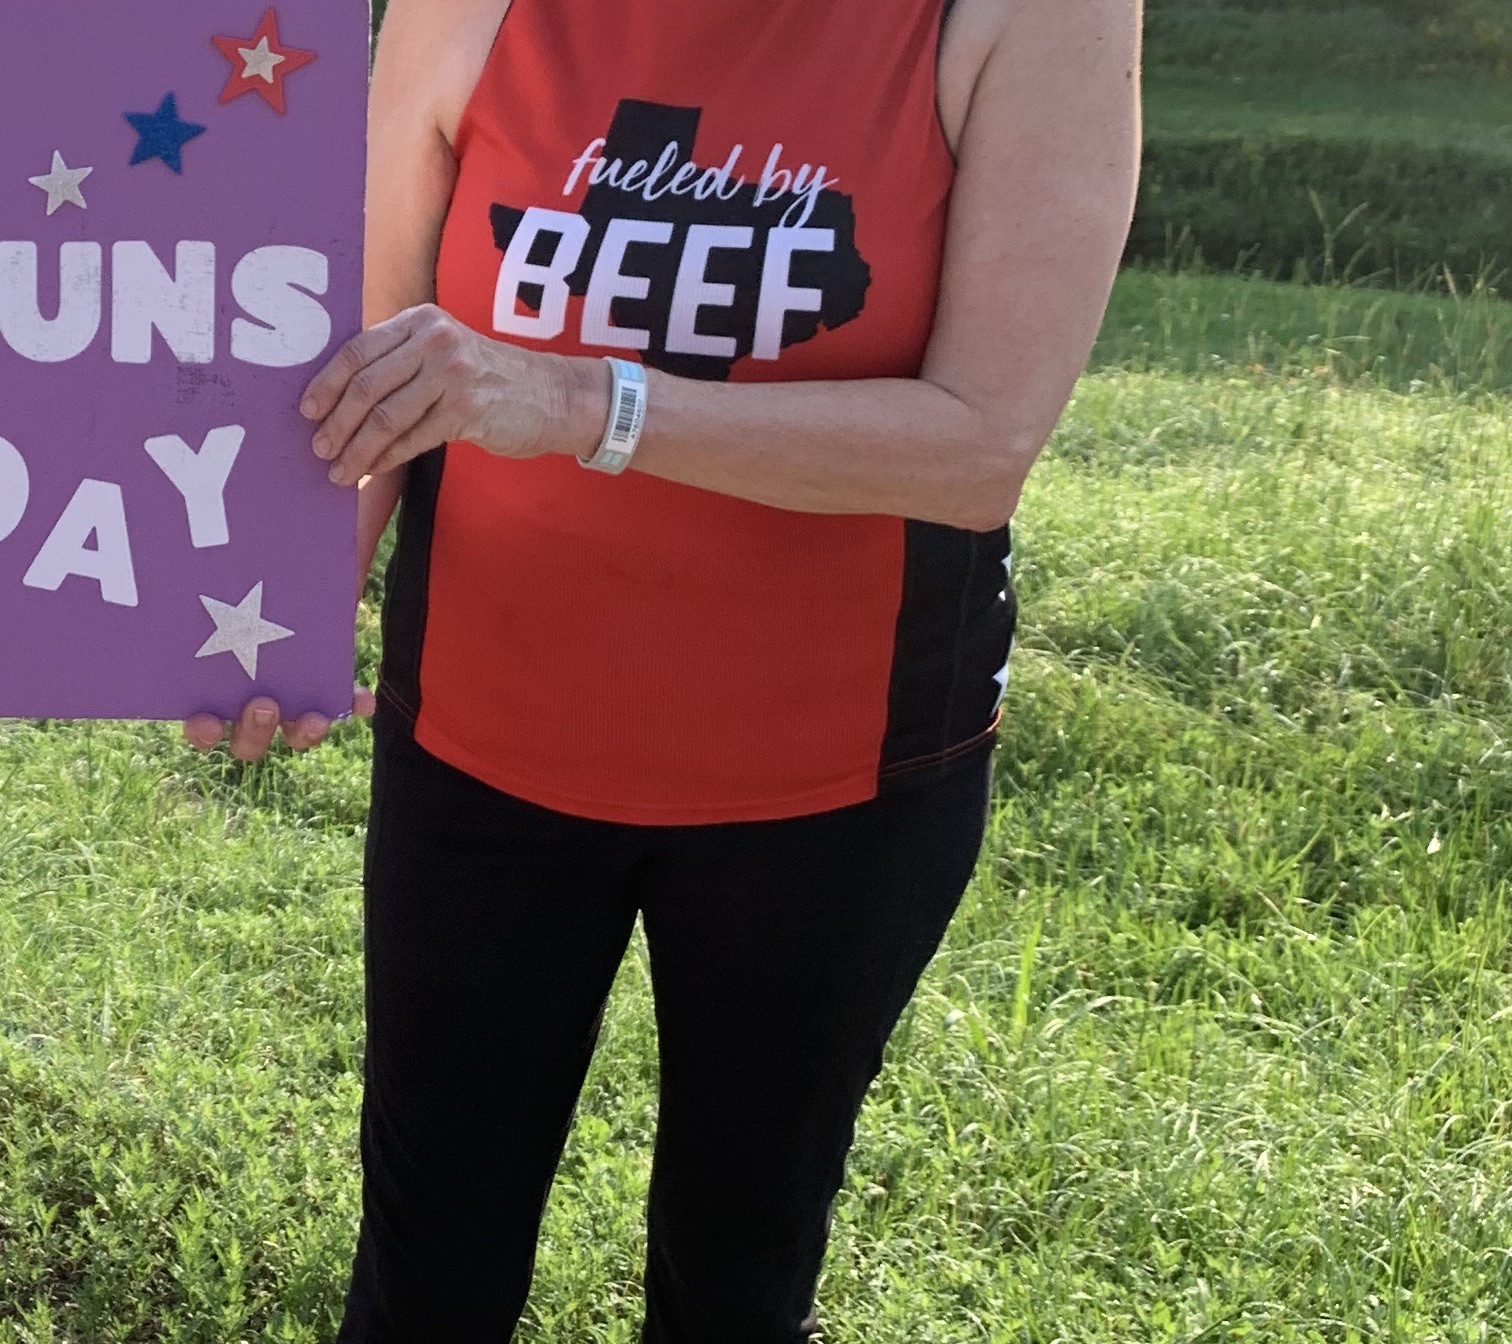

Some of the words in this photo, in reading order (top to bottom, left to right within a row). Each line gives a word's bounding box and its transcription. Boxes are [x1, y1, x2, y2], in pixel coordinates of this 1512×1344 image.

[562, 137, 744, 202] fueled
[752, 143, 840, 229] by
[492, 206, 836, 360] BEEF
